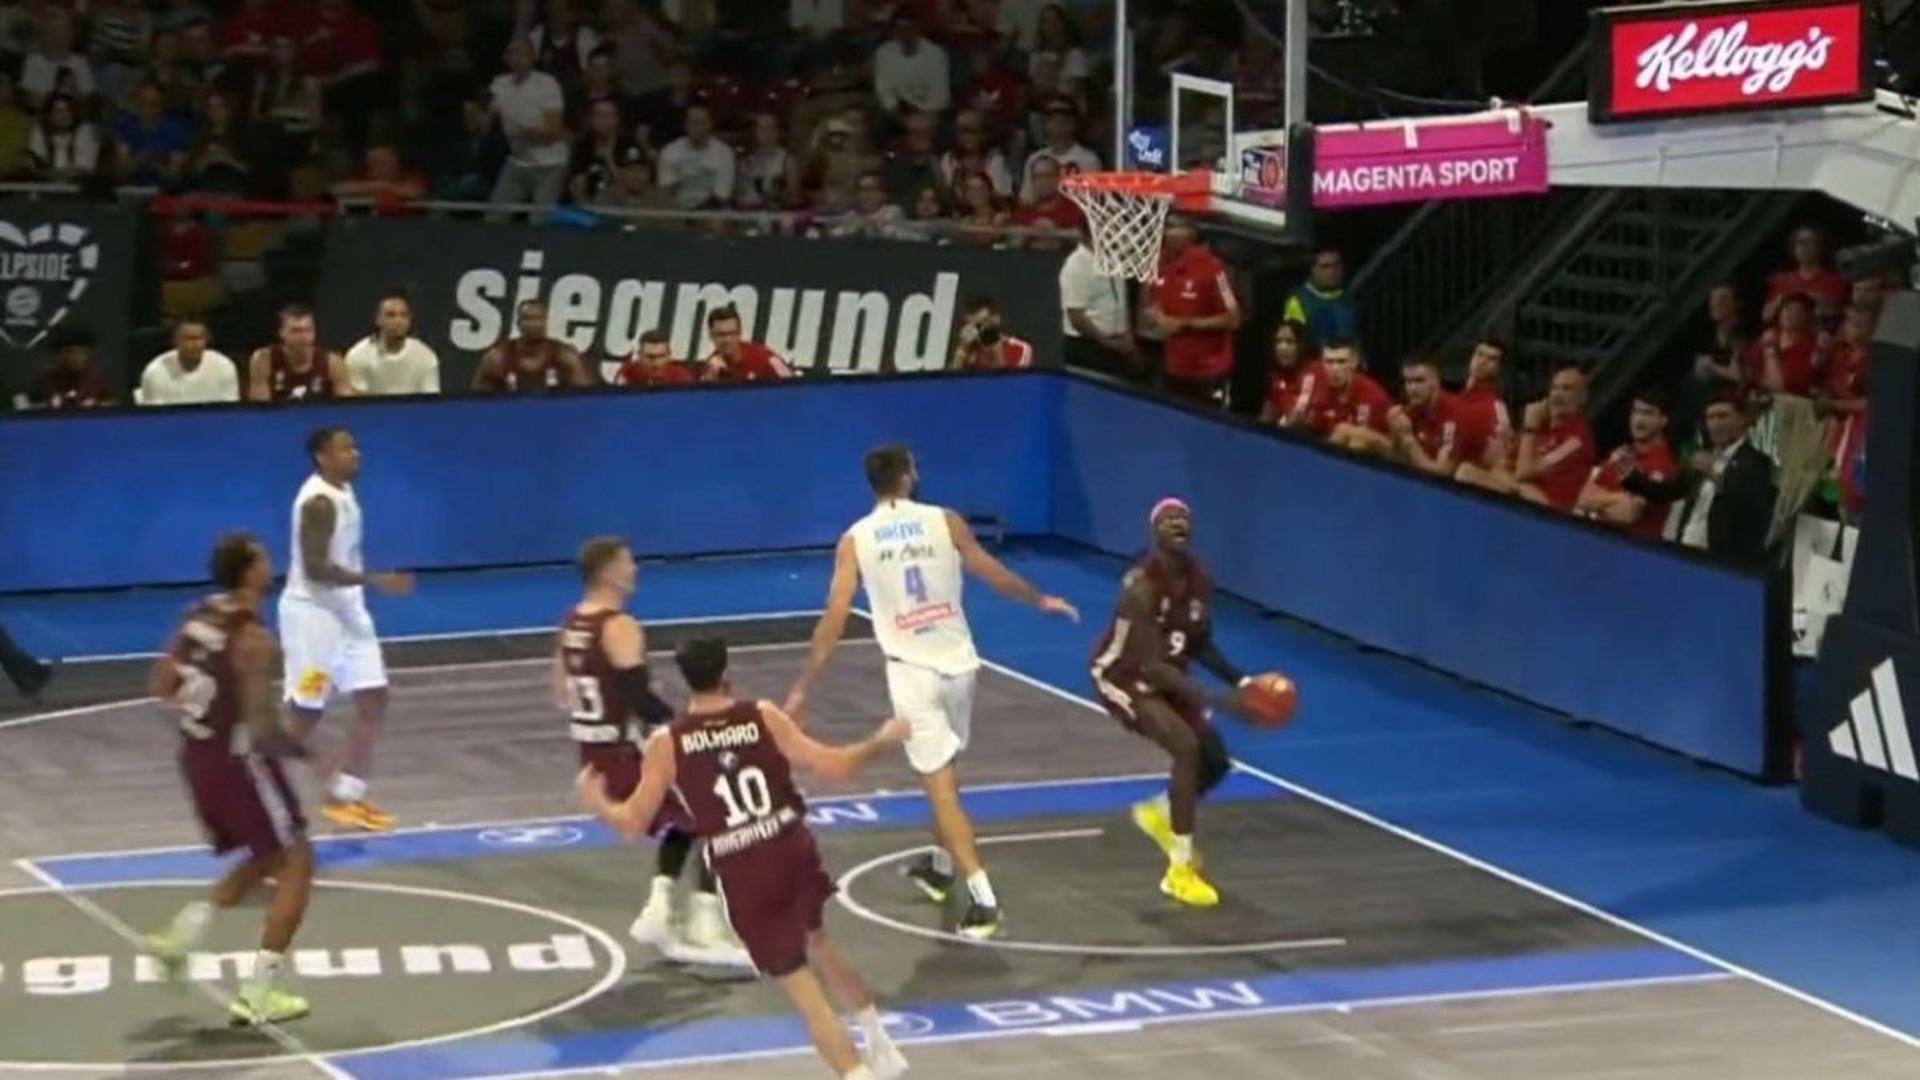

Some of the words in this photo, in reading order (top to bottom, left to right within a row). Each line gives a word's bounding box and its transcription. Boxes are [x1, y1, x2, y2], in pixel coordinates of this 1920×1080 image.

[1635, 19, 1835, 95] Kellogg's
[1312, 163, 1437, 195] MAGENTA
[1439, 157, 1519, 187] SPORT
[0, 251, 73, 281] LPSIDE
[449, 249, 959, 378] siegmund
[1169, 630, 1187, 656] 9
[712, 765, 772, 828] 10
[0, 934, 597, 996] gmund
[966, 980, 1264, 1028] BMW
